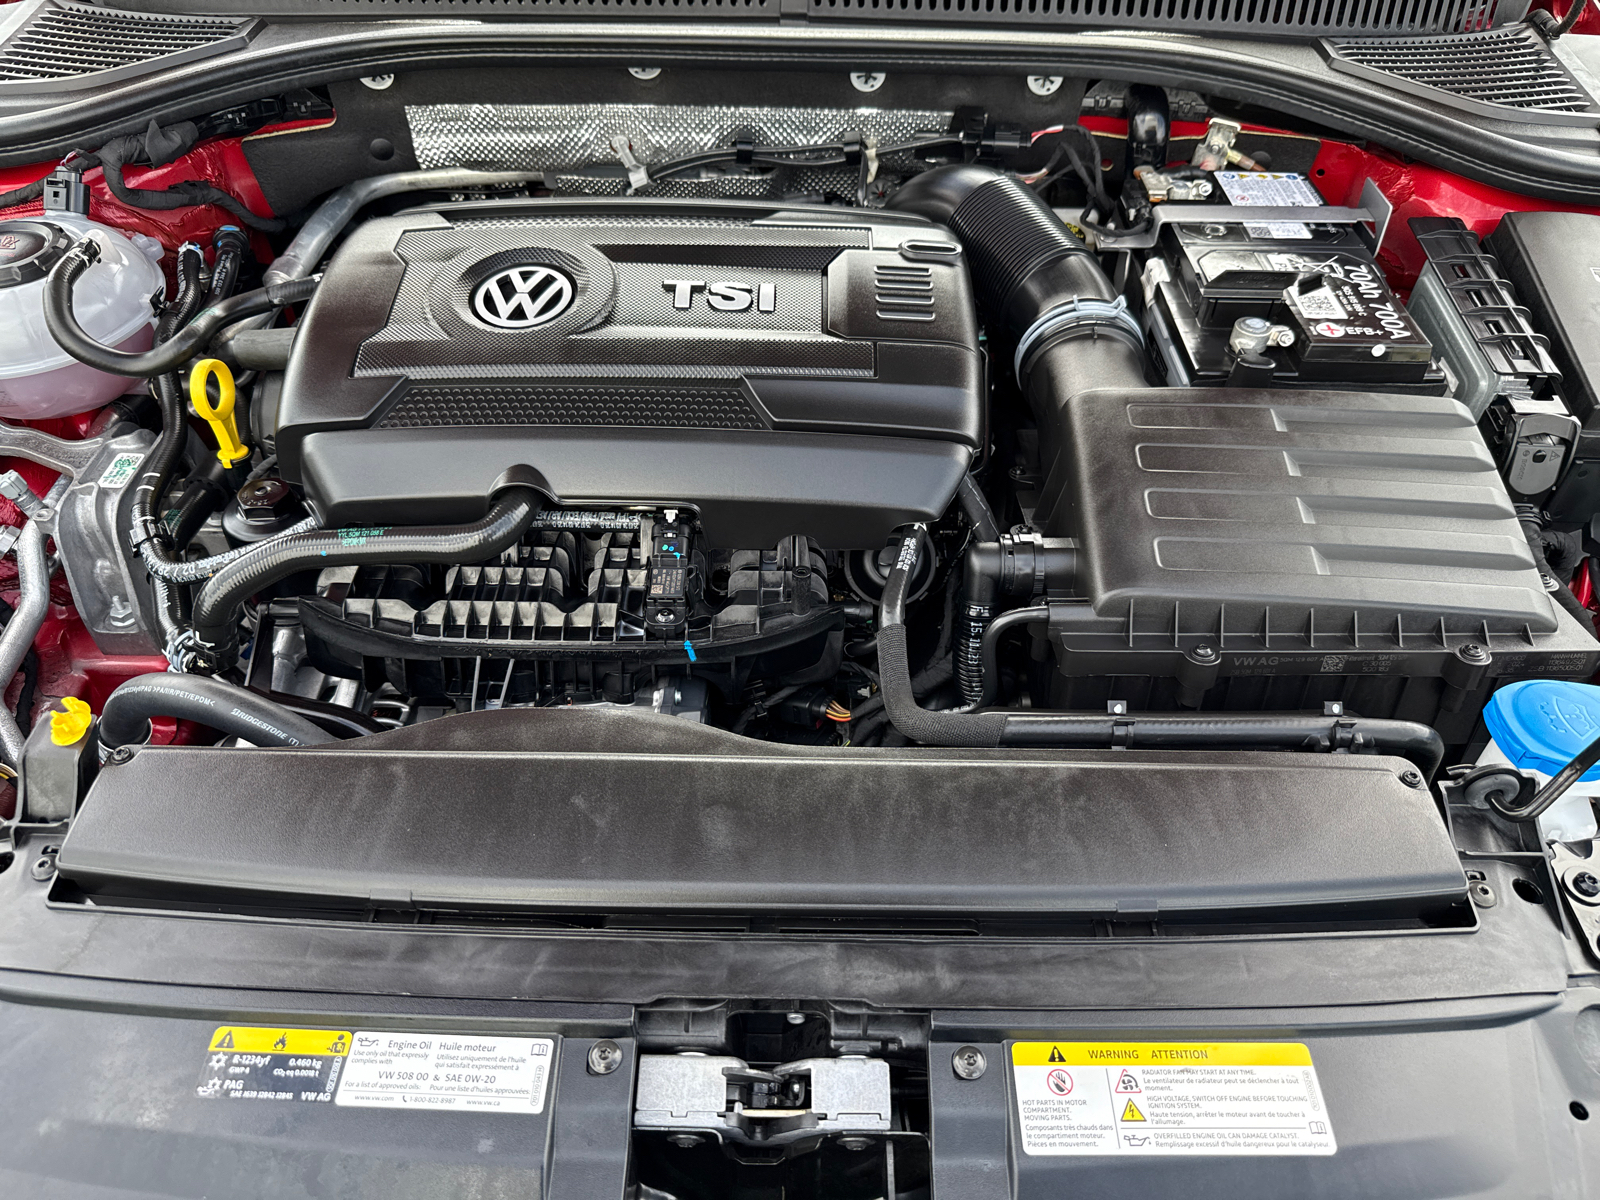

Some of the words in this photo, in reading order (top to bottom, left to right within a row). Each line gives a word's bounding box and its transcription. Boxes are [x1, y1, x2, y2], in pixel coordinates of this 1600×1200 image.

[474, 266, 572, 328] VW
[662, 279, 776, 312] TSI
[1344, 264, 1382, 299] 70Ah
[1368, 302, 1411, 340] 700A
[1345, 326, 1384, 336] EFB+
[1233, 656, 1256, 666] VW
[1256, 656, 1279, 666] AG
[230, 708, 288, 740] BRIDGESTONE
[388, 1039, 417, 1051] Engine
[419, 1041, 432, 1049] Oil
[439, 1042, 462, 1051] Huile
[464, 1044, 497, 1052] moteur
[366, 1050, 379, 1058] only
[401, 1052, 429, 1060] expressly
[436, 1053, 459, 1061] Utilisez
[460, 1055, 498, 1063] uniquement
[1087, 1049, 1140, 1059] WARNING
[1151, 1049, 1209, 1060] ATTENTION
[232, 1054, 271, 1068] R-1234yf
[311, 1059, 322, 1069] kg
[351, 1057, 378, 1065] complies
[471, 1062, 514, 1071] expressément
[378, 1071, 395, 1080] VW
[396, 1071, 415, 1080] 508
[415, 1072, 429, 1081] 00
[445, 1074, 463, 1083] SAE
[464, 1075, 497, 1084] 0W-20
[223, 1079, 244, 1089] PAG
[301, 1091, 317, 1102] VW
[316, 1092, 332, 1102] AG
[409, 1096, 456, 1104] 1-800-822-8987
[1025, 1123, 1063, 1132] Composants
[1076, 1123, 1098, 1131] chauds
[1098, 1123, 1114, 1131] dans
[1033, 1132, 1079, 1140] compartiment
[1027, 1140, 1048, 1148] Pièces
[1058, 1140, 1099, 1148] mouvement.
[1155, 1140, 1194, 1149] Remplissage
[1242, 1140, 1275, 1149] dangereux
